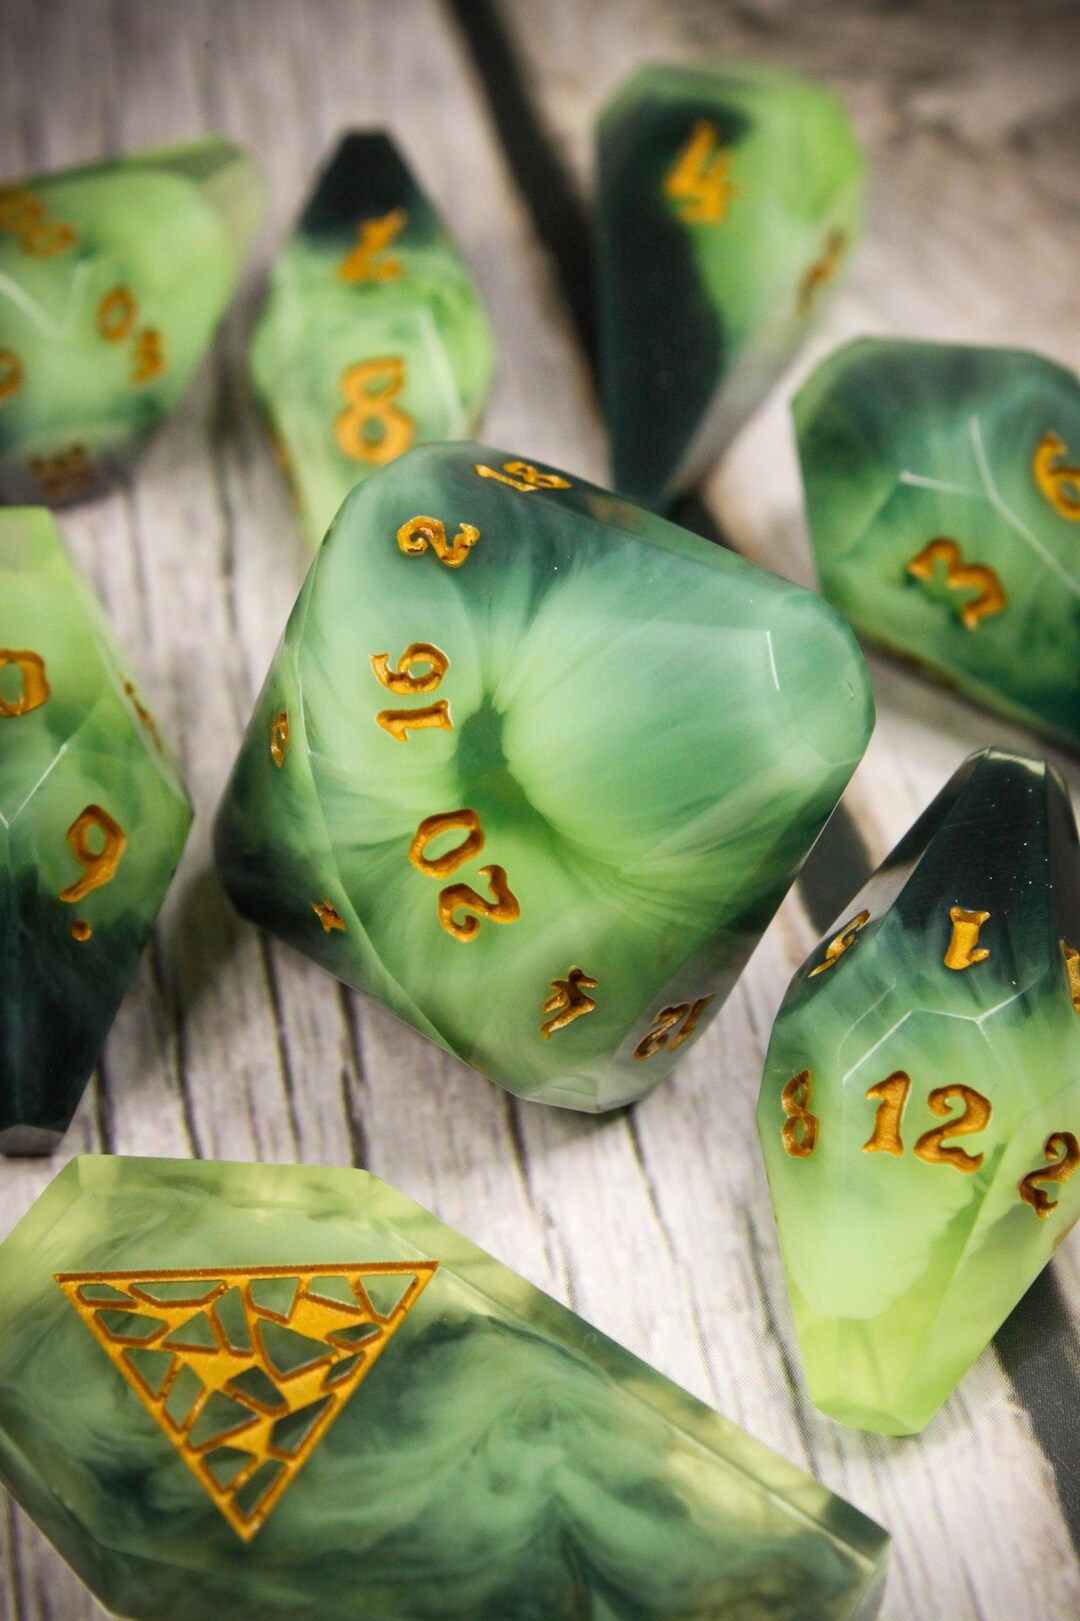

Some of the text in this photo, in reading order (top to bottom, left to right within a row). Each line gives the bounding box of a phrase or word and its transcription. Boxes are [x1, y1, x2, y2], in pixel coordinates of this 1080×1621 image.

[333, 355, 416, 466] 8
[397, 515, 480, 568] 2
[909, 538, 1007, 629] 3
[370, 641, 454, 742] 16
[408, 807, 521, 943] 20
[943, 906, 991, 971] 1
[781, 1069, 819, 1160] 8
[862, 1070, 993, 1175] 12
[1017, 1131, 1080, 1220] 2
